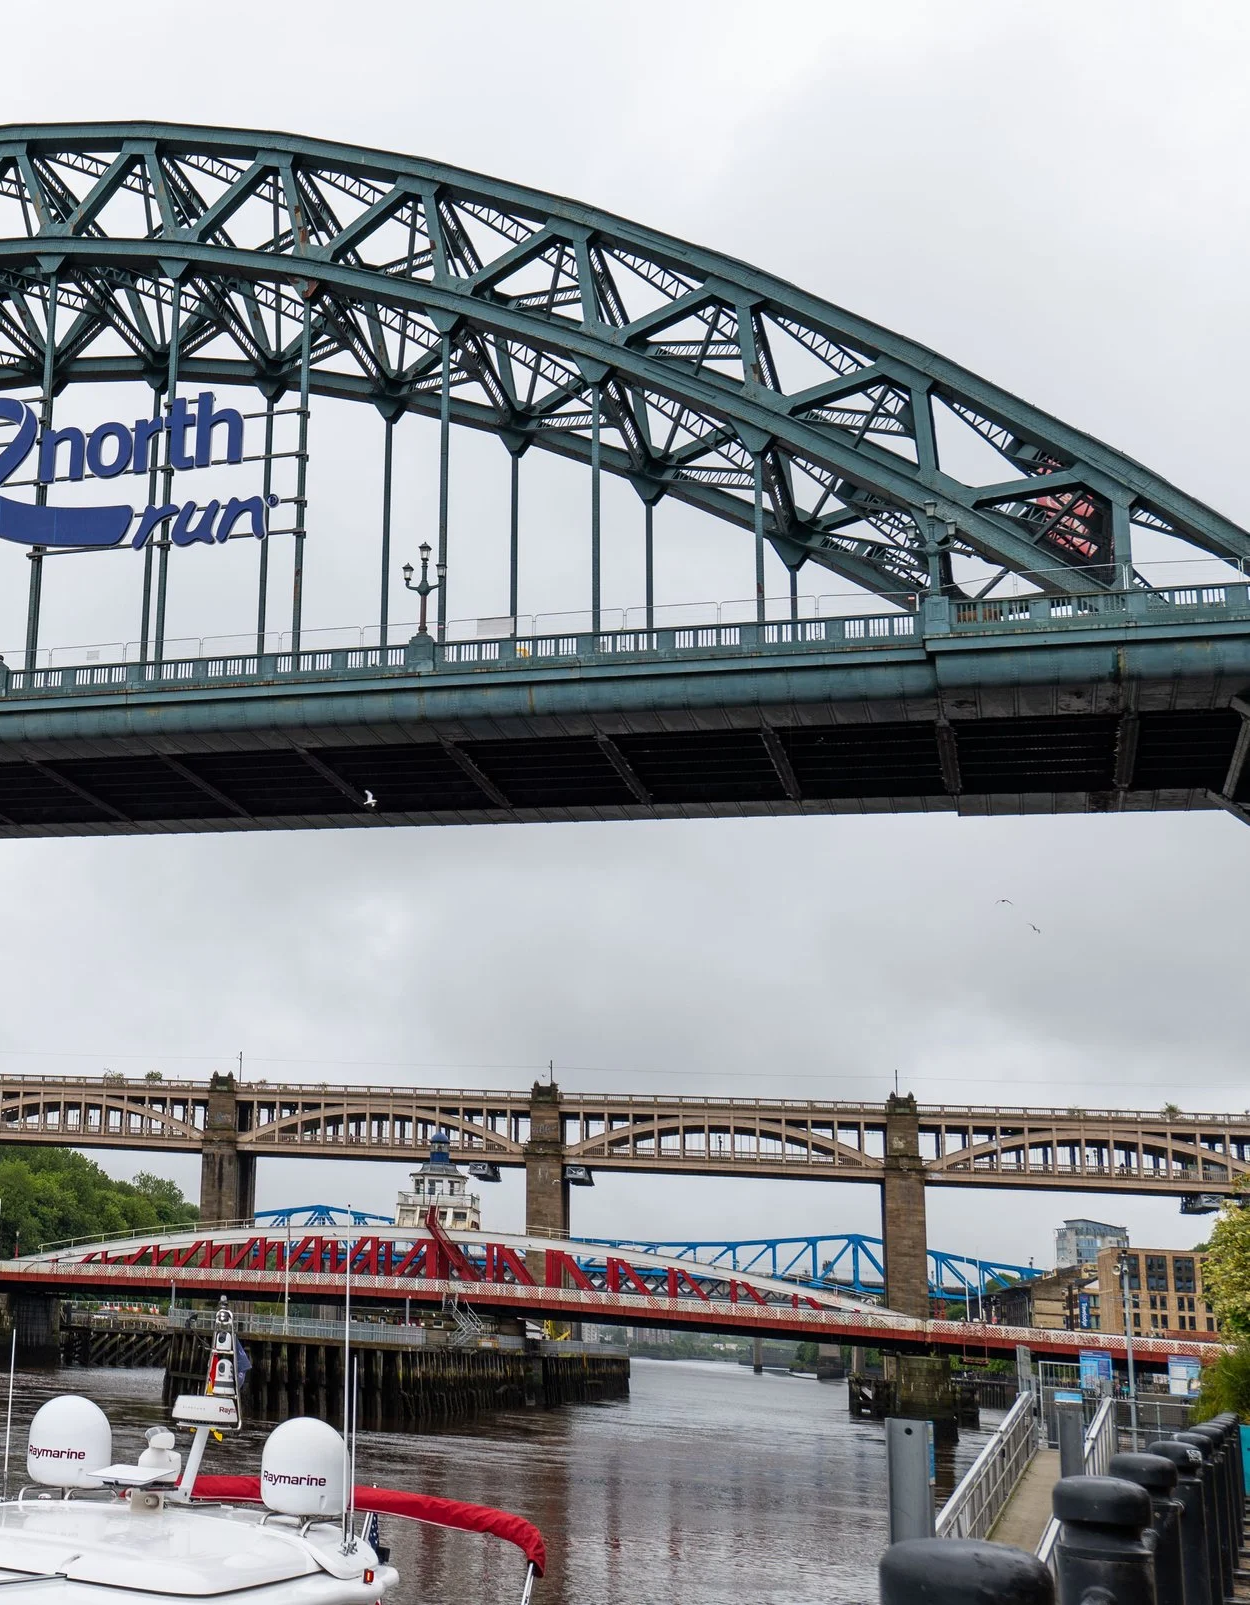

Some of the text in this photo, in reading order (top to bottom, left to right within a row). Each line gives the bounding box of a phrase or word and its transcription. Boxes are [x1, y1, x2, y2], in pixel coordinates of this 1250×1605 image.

[39, 391, 245, 485] north
[29, 1444, 86, 1460] Raymarine
[263, 1470, 327, 1487] Raymarine
